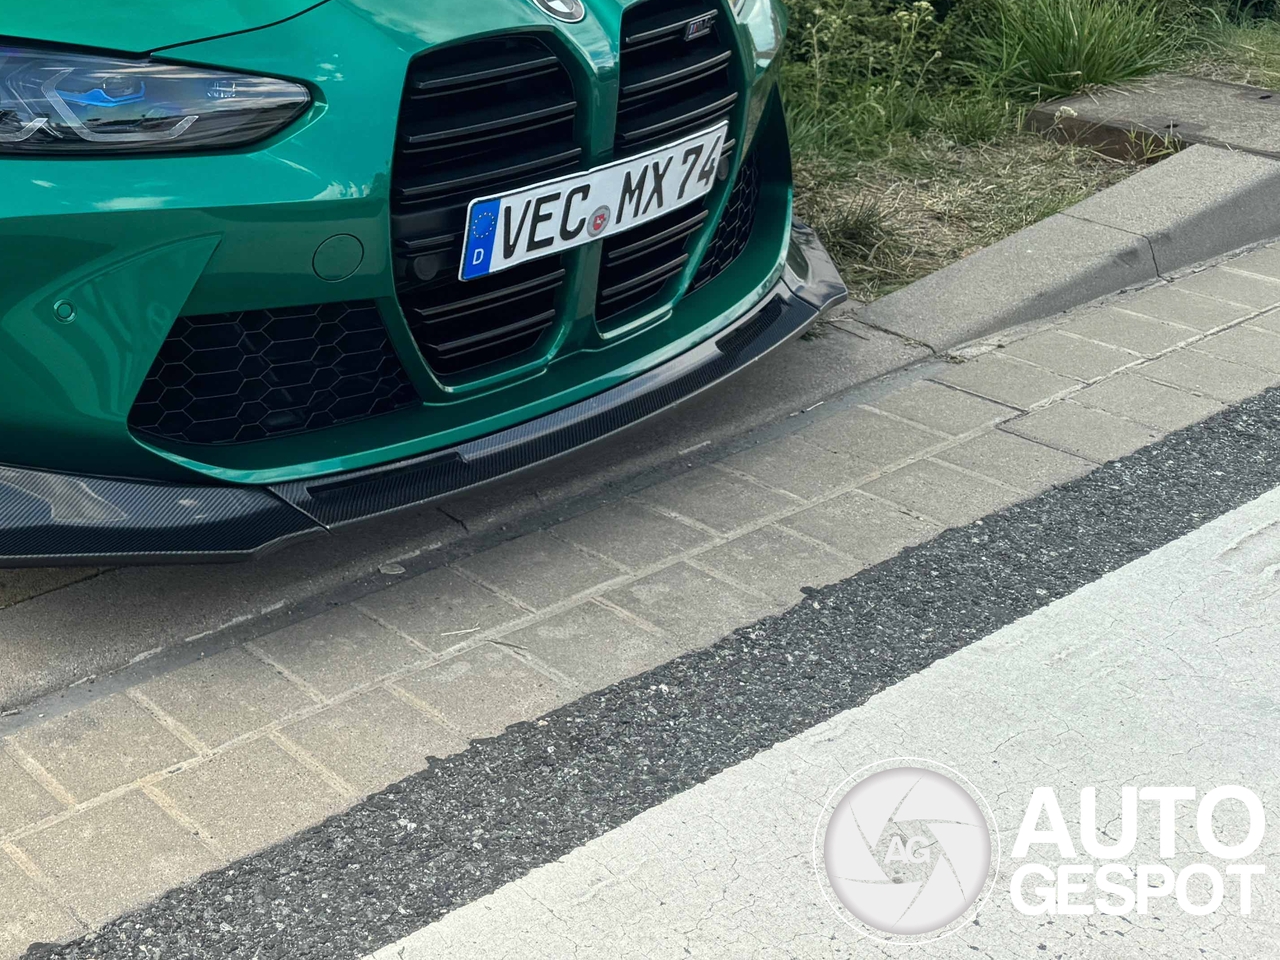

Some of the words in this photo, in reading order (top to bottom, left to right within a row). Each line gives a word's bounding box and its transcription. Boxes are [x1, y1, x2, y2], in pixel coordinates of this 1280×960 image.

[503, 183, 590, 260] VEC
[615, 155, 674, 226] MX
[677, 134, 721, 200] 74
[472, 248, 484, 266] D
